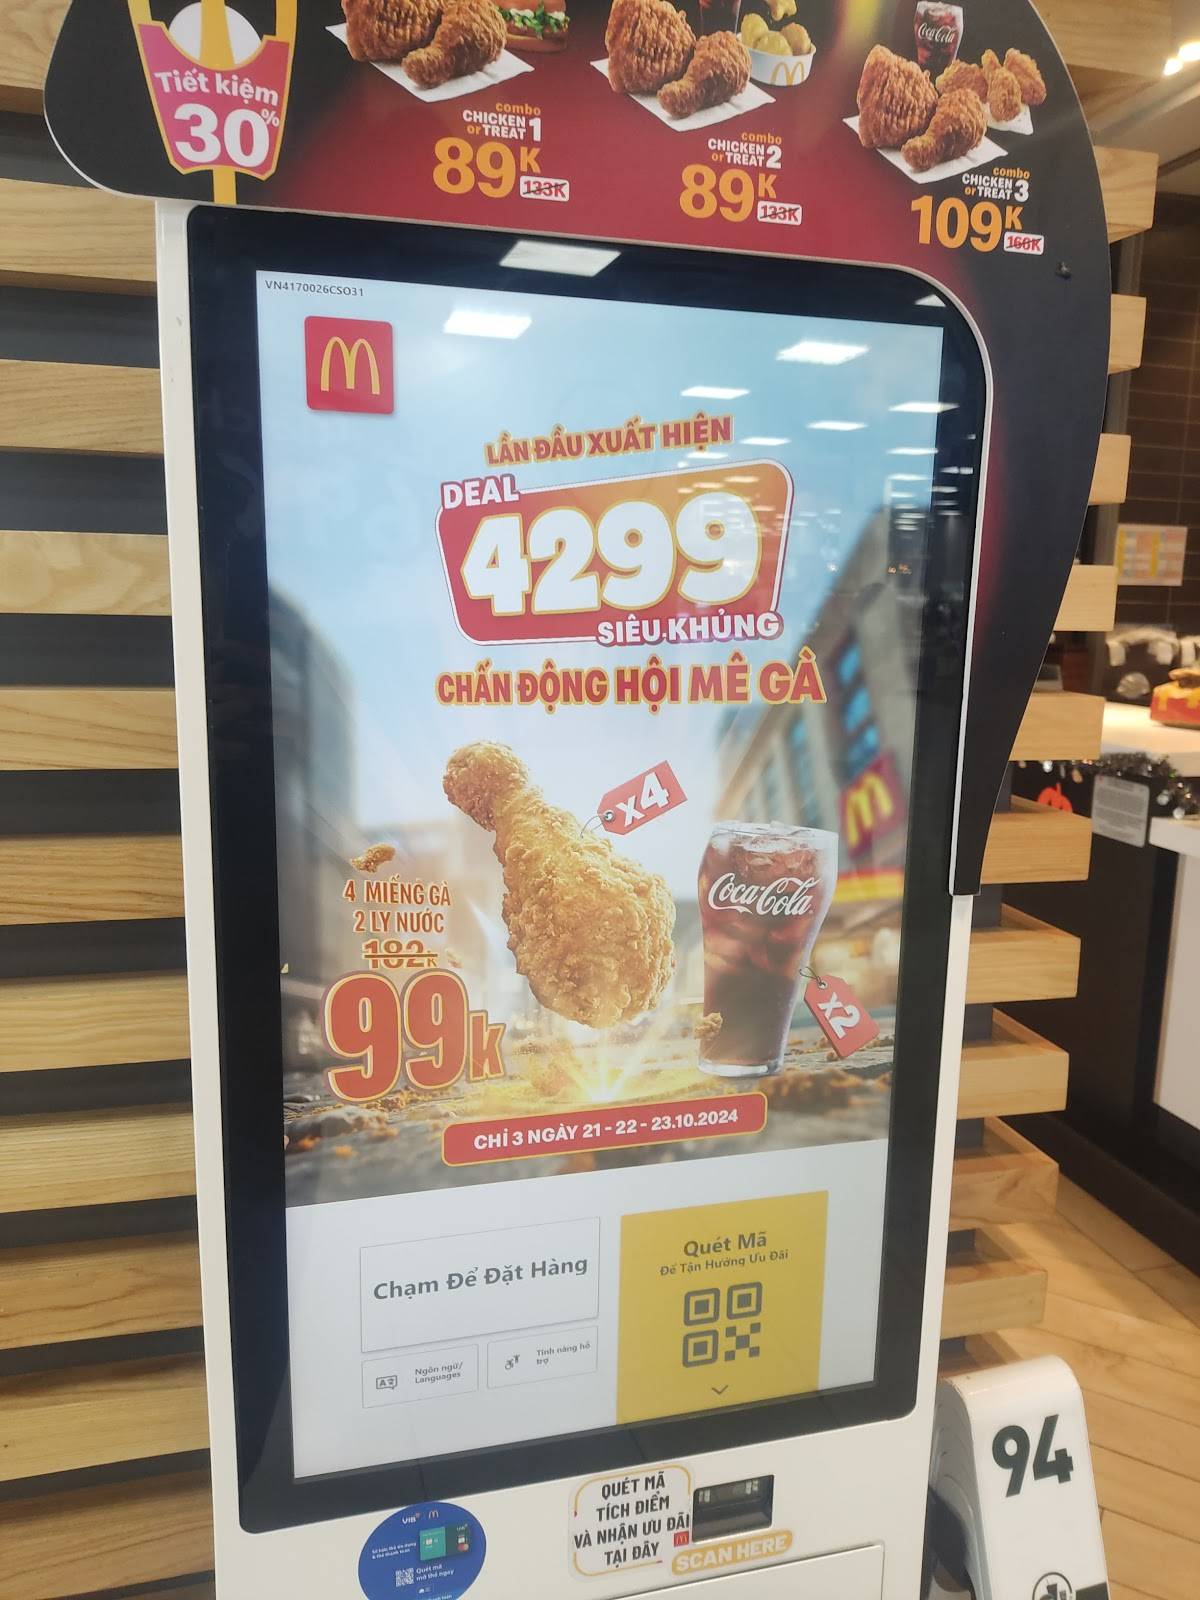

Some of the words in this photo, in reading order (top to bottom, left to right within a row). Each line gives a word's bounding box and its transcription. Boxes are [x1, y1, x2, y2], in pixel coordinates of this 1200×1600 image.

[154, 68, 210, 93] Tiết
[215, 73, 278, 106] kiệm
[463, 109, 526, 128] CHICKEN
[495, 102, 541, 116] combo
[467, 124, 481, 136] or
[482, 123, 526, 141] TREAT
[529, 117, 541, 142] 1
[741, 132, 782, 145] combo
[707, 138, 765, 156] CHICKEN
[711, 152, 724, 162] or
[725, 152, 765, 167] TREAT
[766, 145, 782, 169] 2
[962, 173, 1012, 189] CHICKEN
[992, 167, 1030, 179] combo
[523, 180, 567, 198] 133K
[964, 185, 976, 196] or
[977, 186, 1012, 200] TREAT
[1014, 179, 1029, 202] 3
[760, 204, 799, 222] 133K
[485, 433, 529, 466] LẦN
[534, 426, 583, 461] ĐẦU
[588, 416, 656, 456] XUẤT
[662, 410, 732, 454] HIỆN
[442, 476, 519, 509] DEAL
[460, 491, 762, 616] 4299
[598, 614, 661, 644] SIÊU
[668, 608, 781, 641] KHỦNG
[437, 659, 511, 704] CHẤN
[517, 657, 608, 714] ĐỘNG
[615, 654, 681, 714] HỘI
[689, 650, 749, 703] MÊ
[759, 647, 828, 703] GÀ
[615, 771, 669, 827] x4
[343, 880, 355, 902] 4
[366, 875, 424, 904] MIẾNG
[429, 880, 450, 906] GÀ
[354, 911, 365, 932] 2
[370, 911, 391, 932] LY
[397, 908, 444, 933] NƯỚC
[817, 992, 861, 1039] x2
[474, 1128, 508, 1149] CHỈ
[512, 1131, 523, 1145] 3
[528, 1123, 578, 1143] NGÀY
[583, 1123, 601, 1138] 21
[616, 1120, 637, 1135] 22
[651, 1108, 738, 1131] 23.10.2024
[684, 1237, 731, 1257] Quét
[738, 1231, 767, 1250] Mã
[373, 1280, 439, 1300] Chạm
[446, 1267, 479, 1290] Để
[484, 1265, 523, 1286] Đặt
[531, 1258, 588, 1278] Hàng
[415, 1366, 439, 1376] Ngôn
[415, 1372, 461, 1383] Languages
[992, 1414, 1074, 1498] 94
[601, 1478, 640, 1500] QUÉT
[644, 1471, 665, 1490] MÃ
[596, 1502, 630, 1522] TÍCH
[635, 1491, 670, 1513] ĐIỂM
[574, 1530, 592, 1549] VÀ
[597, 1523, 638, 1545] NHẬN
[642, 1517, 662, 1535] ƯU
[667, 1512, 690, 1531] ĐÃI
[604, 1548, 627, 1568] TẠI
[632, 1542, 660, 1560] ĐÂY
[676, 1544, 732, 1571] SCAN
[736, 1536, 787, 1560] HERE
